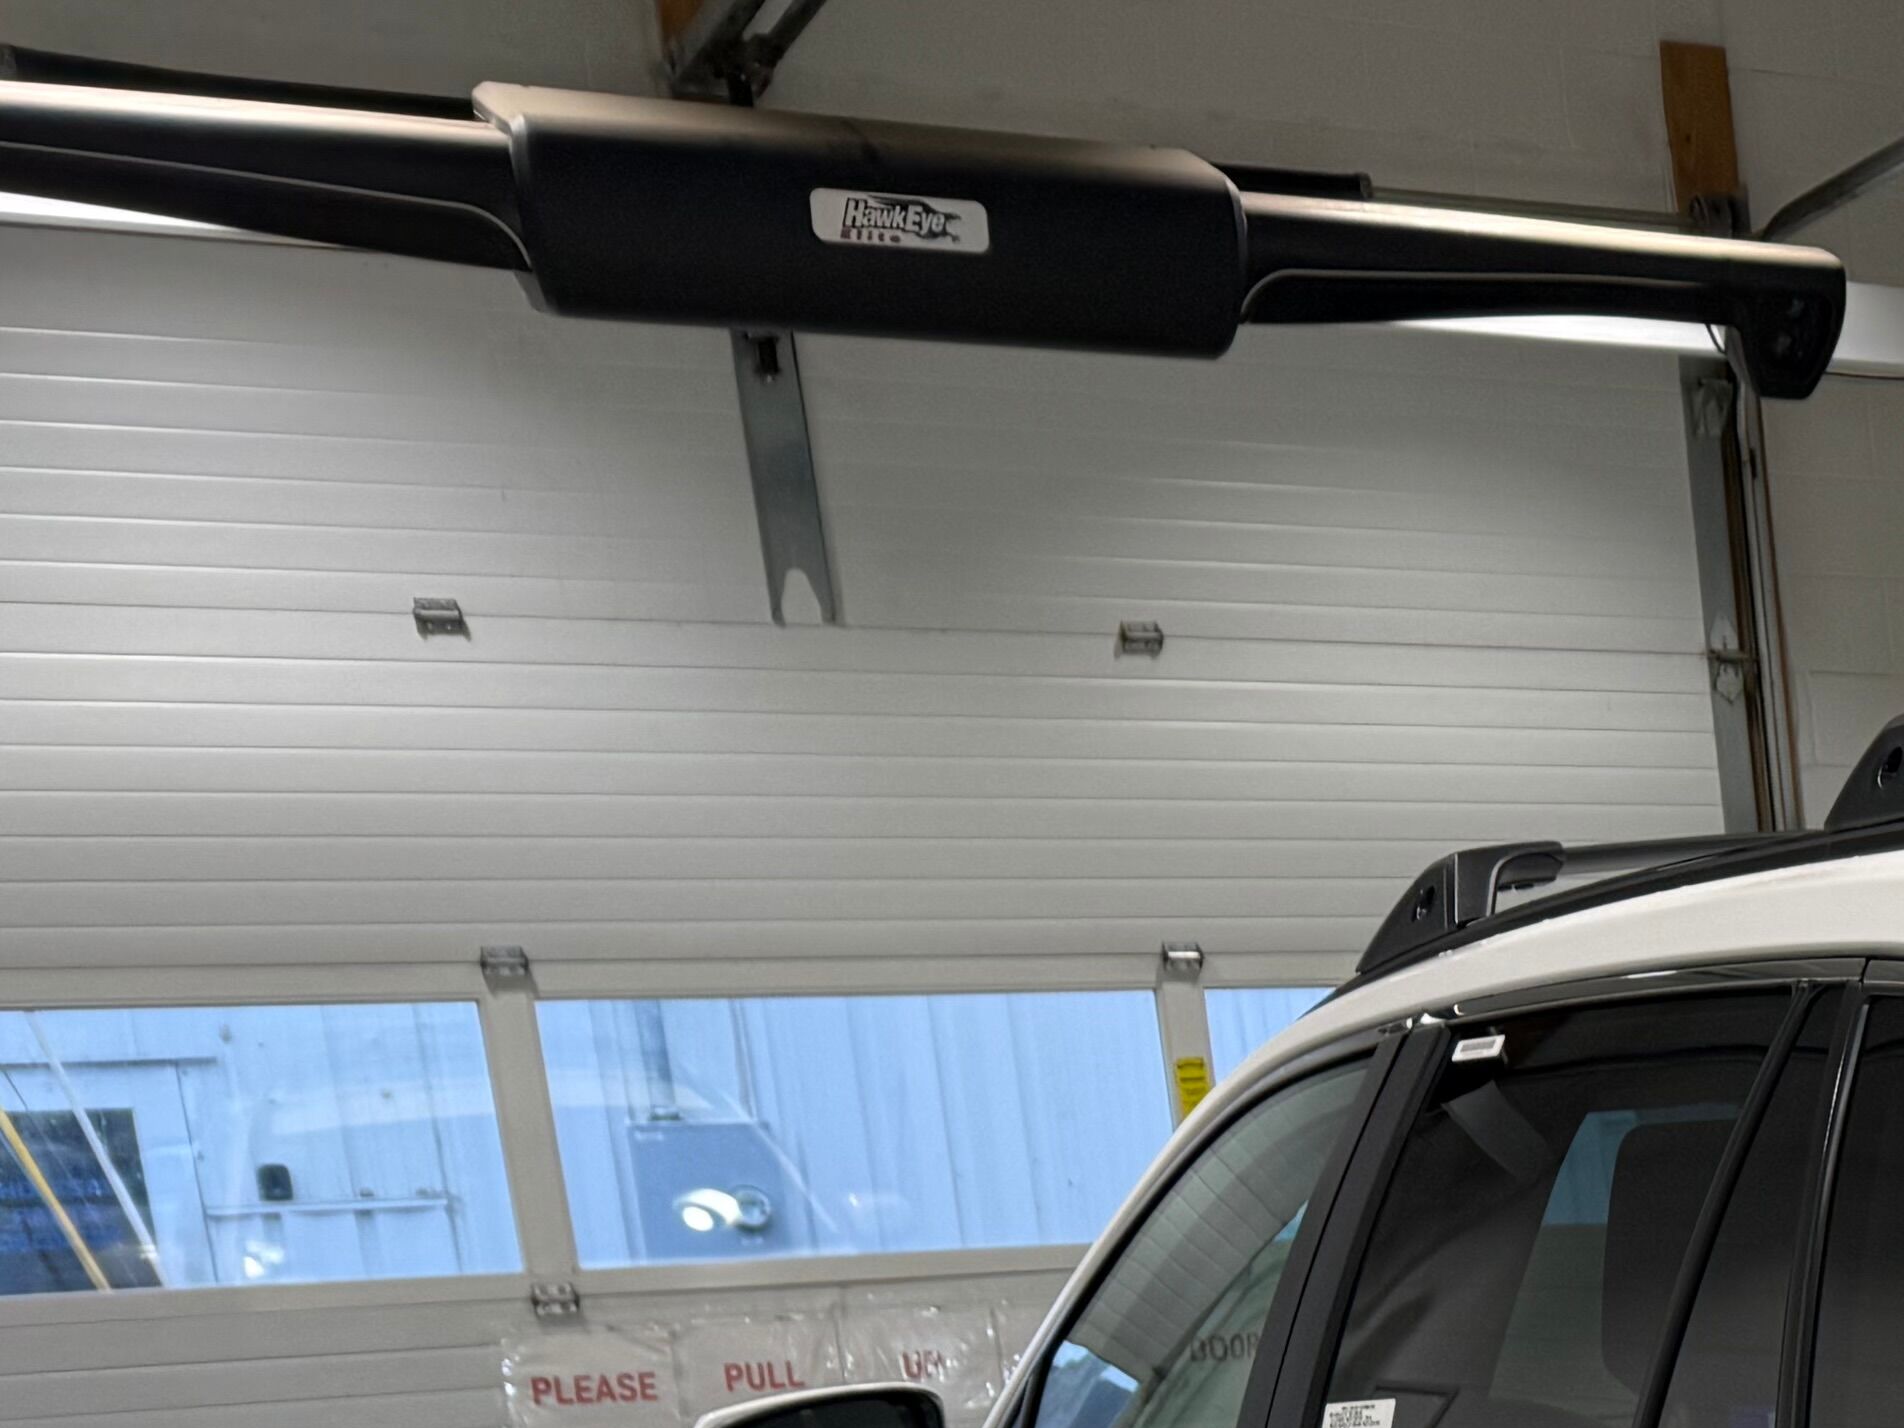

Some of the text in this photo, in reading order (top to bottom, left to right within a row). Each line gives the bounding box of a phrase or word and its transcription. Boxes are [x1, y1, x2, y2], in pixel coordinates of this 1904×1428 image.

[845, 198, 945, 235] HawkEye
[530, 1371, 658, 1405] PLEASE
[723, 1361, 805, 1392] PULL
